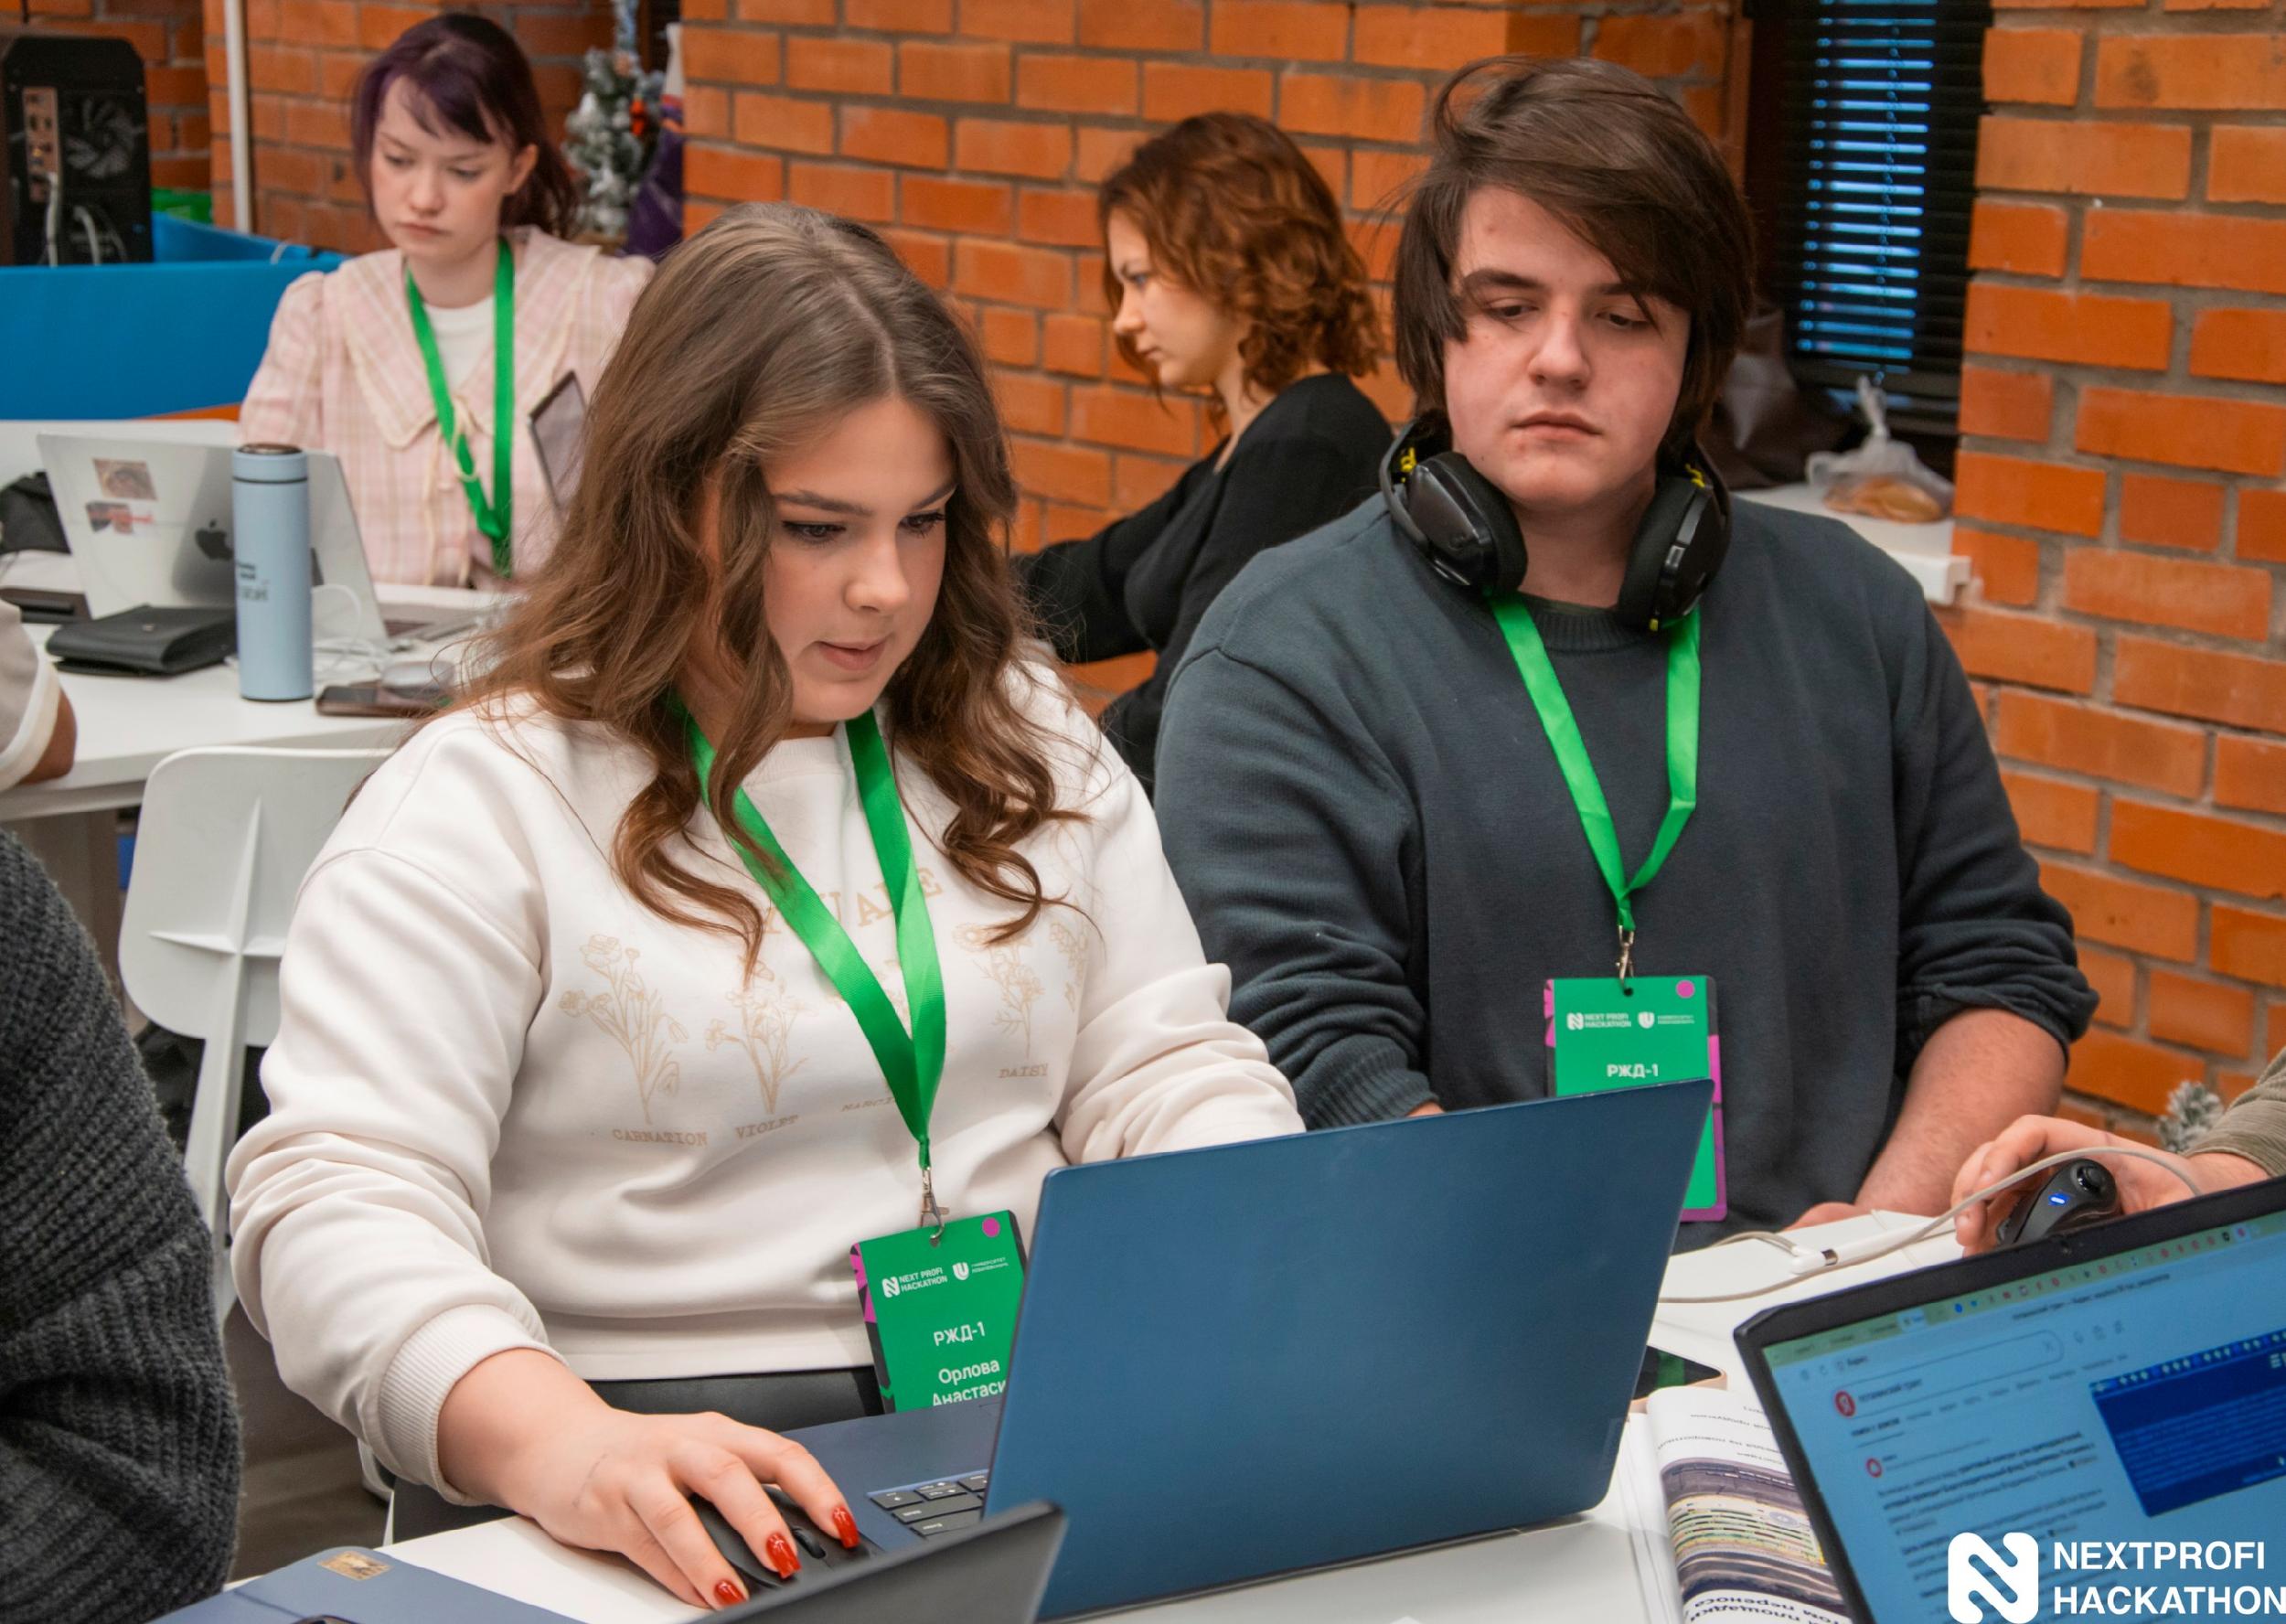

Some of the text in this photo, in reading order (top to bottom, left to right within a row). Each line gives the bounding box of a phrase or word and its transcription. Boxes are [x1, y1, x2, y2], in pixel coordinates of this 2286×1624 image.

[998, 1063, 1049, 1079] DAISY
[1607, 1063, 1659, 1079] РЖД-1
[839, 1096, 895, 1112] NARCI
[612, 1128, 708, 1146] CARNATION
[899, 1266, 943, 1284] NEXT PROFI
[901, 1276, 948, 1292] HACKATHON
[933, 1320, 986, 1346] РЖД-1
[938, 1360, 1000, 1386] Орлова
[1694, 1597, 1795, 1611] переноса
